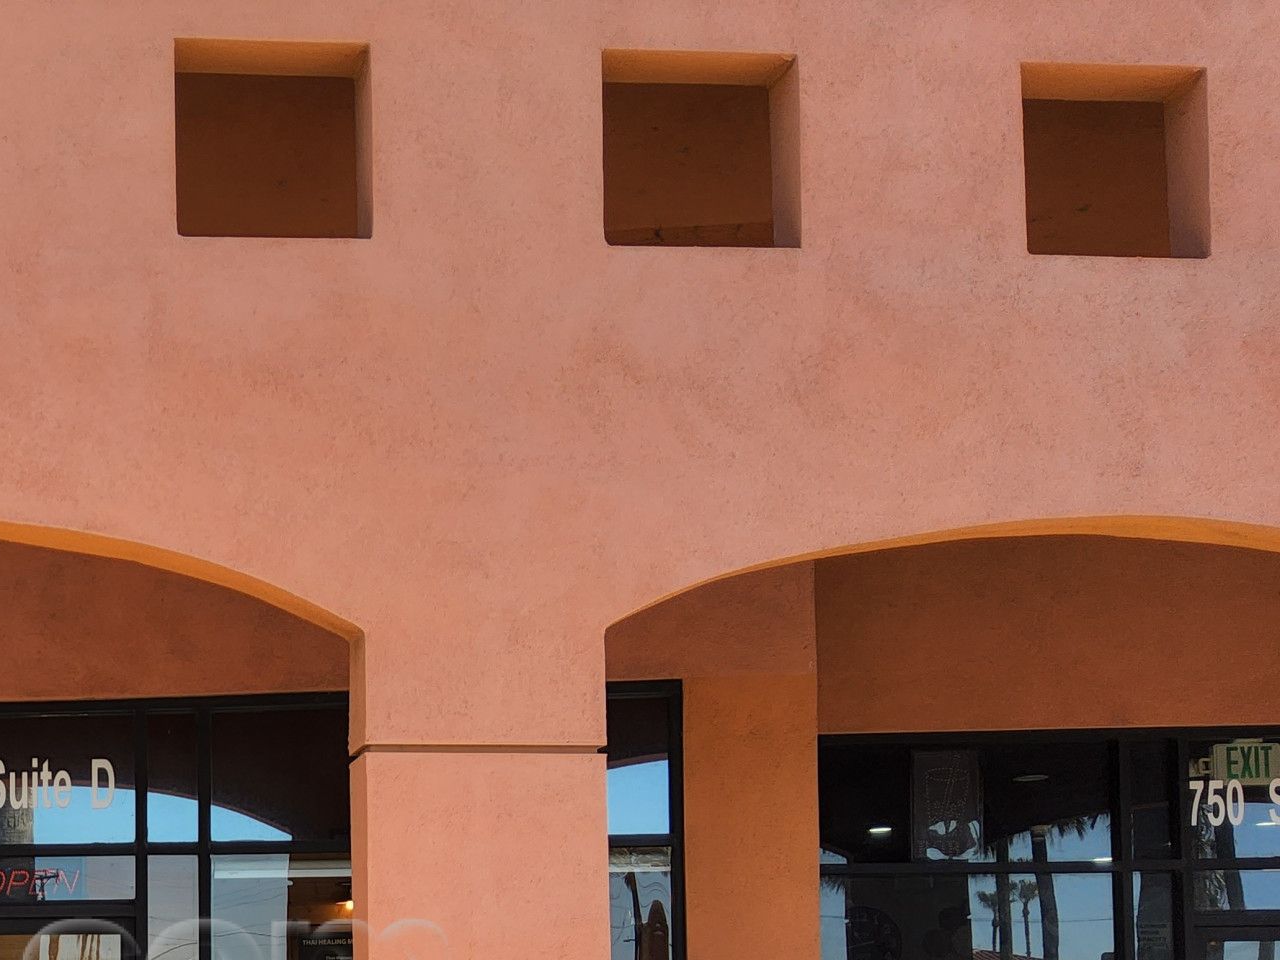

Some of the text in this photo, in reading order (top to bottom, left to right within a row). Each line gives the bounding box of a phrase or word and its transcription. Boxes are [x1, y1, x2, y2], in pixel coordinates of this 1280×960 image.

[91, 758, 115, 810] D
[1226, 745, 1273, 779] EXIT
[1188, 778, 1245, 827] 750
